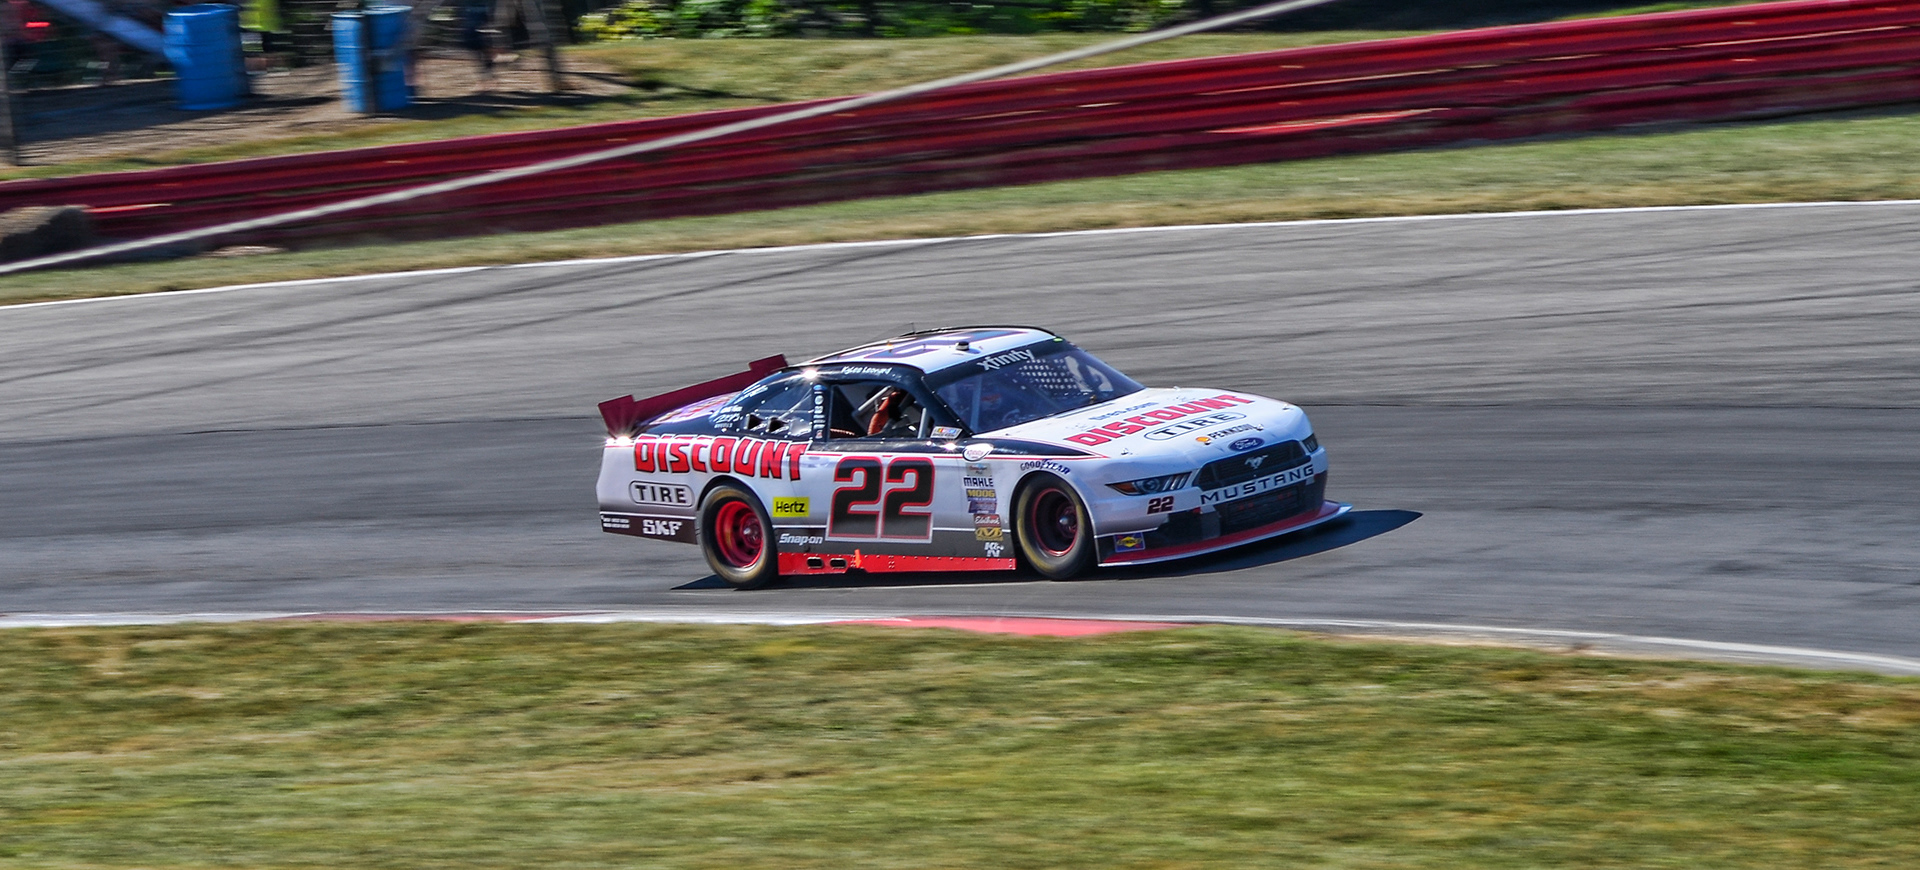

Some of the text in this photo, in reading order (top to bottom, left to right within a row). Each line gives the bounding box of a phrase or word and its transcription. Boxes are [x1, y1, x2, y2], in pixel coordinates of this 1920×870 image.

[977, 349, 1035, 371] xfinity
[1063, 394, 1255, 446] DISCOUNT
[1154, 414, 1237, 436] TIRE
[1234, 438, 1258, 450] Ford
[634, 434, 812, 481] DISCOUNT
[963, 477, 994, 487] MAHLE
[1200, 464, 1314, 505] MUSTANG
[635, 484, 687, 504] TIRE
[826, 455, 935, 542] 22
[967, 489, 995, 498] MOOG
[775, 501, 805, 513] Hertz
[1147, 496, 1174, 515] 22
[642, 519, 683, 536] SKF
[779, 533, 823, 546] Snap-on
